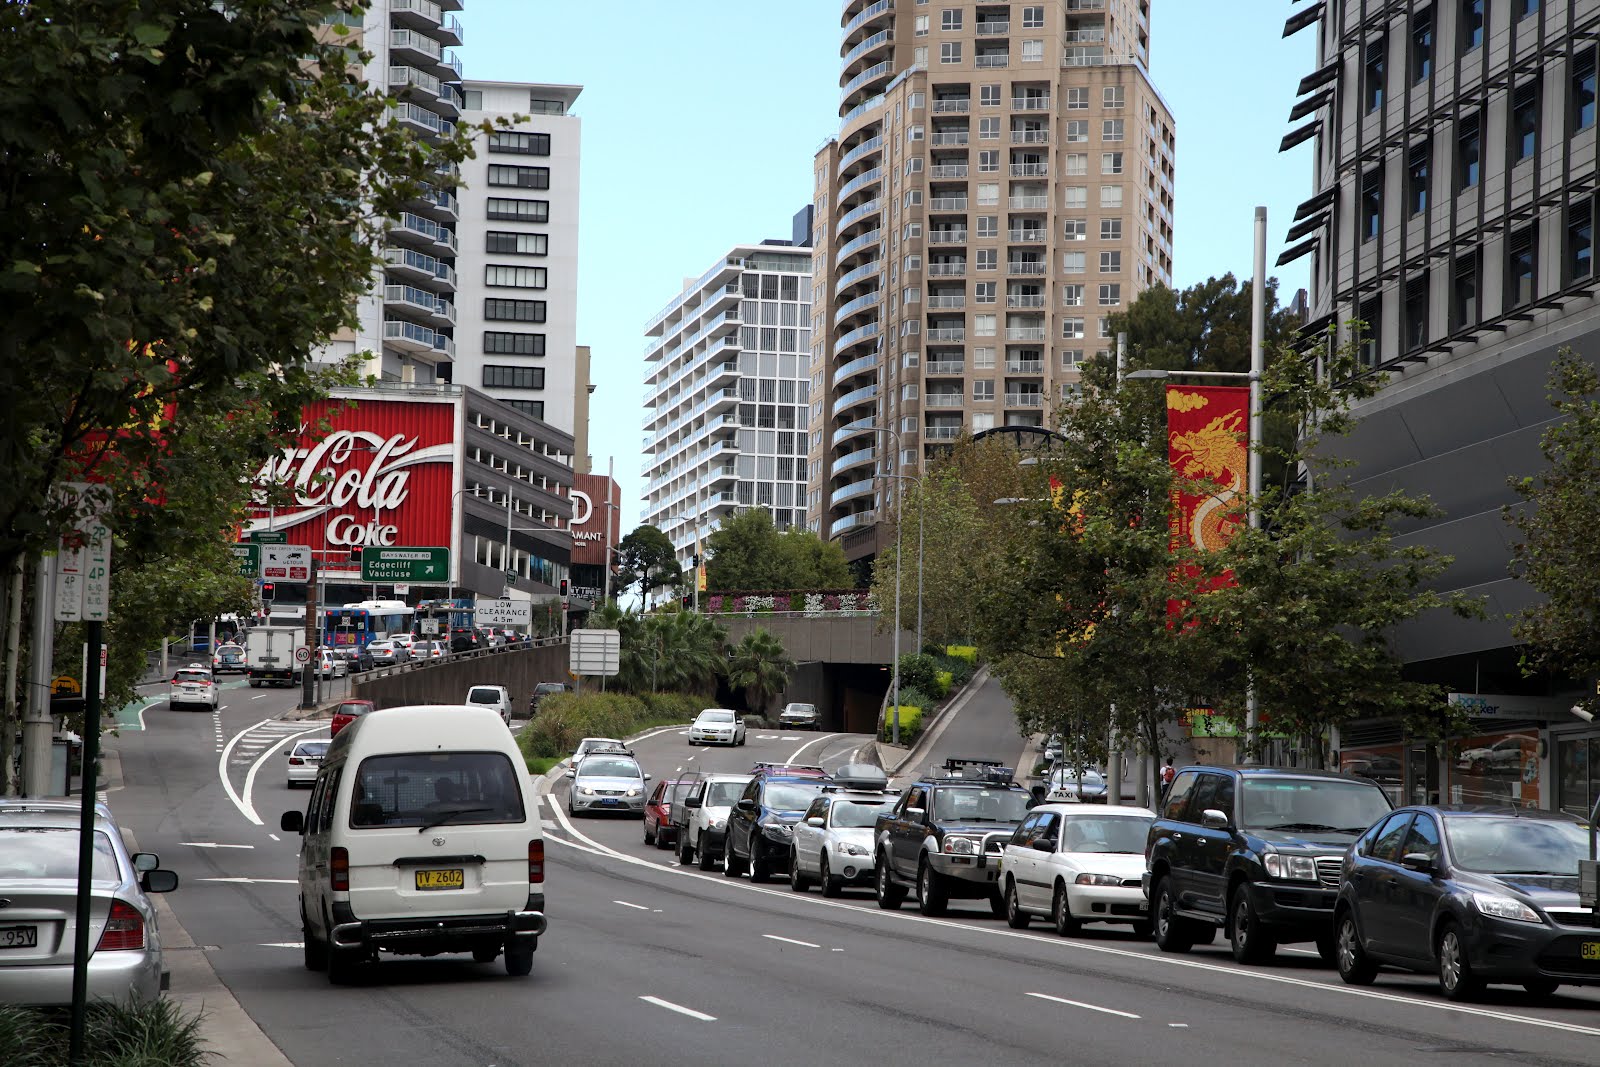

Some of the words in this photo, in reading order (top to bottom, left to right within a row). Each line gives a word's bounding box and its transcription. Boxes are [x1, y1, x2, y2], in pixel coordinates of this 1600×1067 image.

[92, 526, 106, 540] 2P
[326, 514, 398, 547] Coke
[571, 530, 602, 542] AMANT
[369, 561, 411, 570] Edgecliff
[88, 567, 105, 580] 4P
[368, 570, 411, 578] Vaucluse
[64, 576, 75, 585] 4P
[478, 608, 528, 616] CLEARANCE
[298, 651, 308, 659] 60
